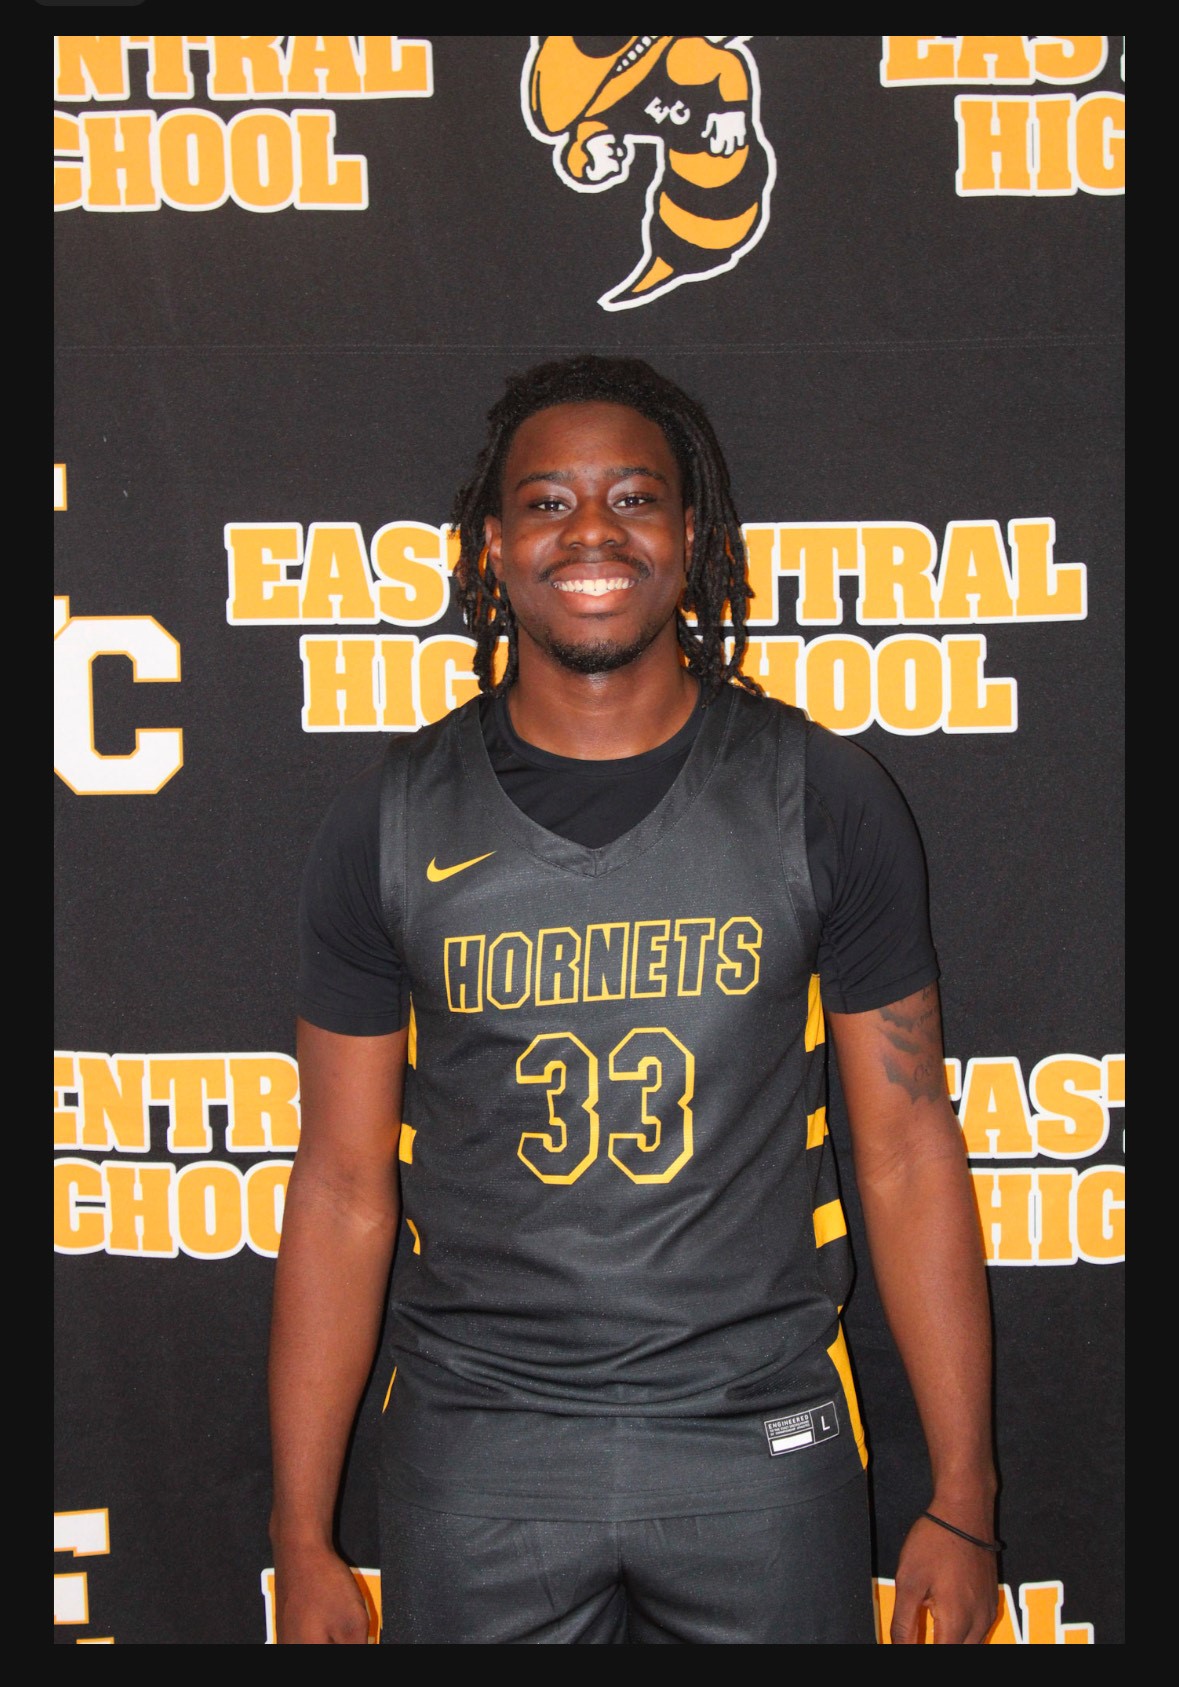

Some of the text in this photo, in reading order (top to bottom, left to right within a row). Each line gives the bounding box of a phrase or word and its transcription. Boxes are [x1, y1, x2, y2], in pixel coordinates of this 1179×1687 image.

[644, 96, 691, 125] EC
[880, 36, 1126, 88] EAS
[223, 517, 1088, 627] EAS TRAL
[299, 634, 508, 732] HIG
[444, 916, 763, 1014] HORNETS
[516, 1027, 695, 1185] 33
[944, 1053, 1125, 1160] AS
[768, 1414, 809, 1430] ENGINEERED
[821, 1415, 831, 1431] L
